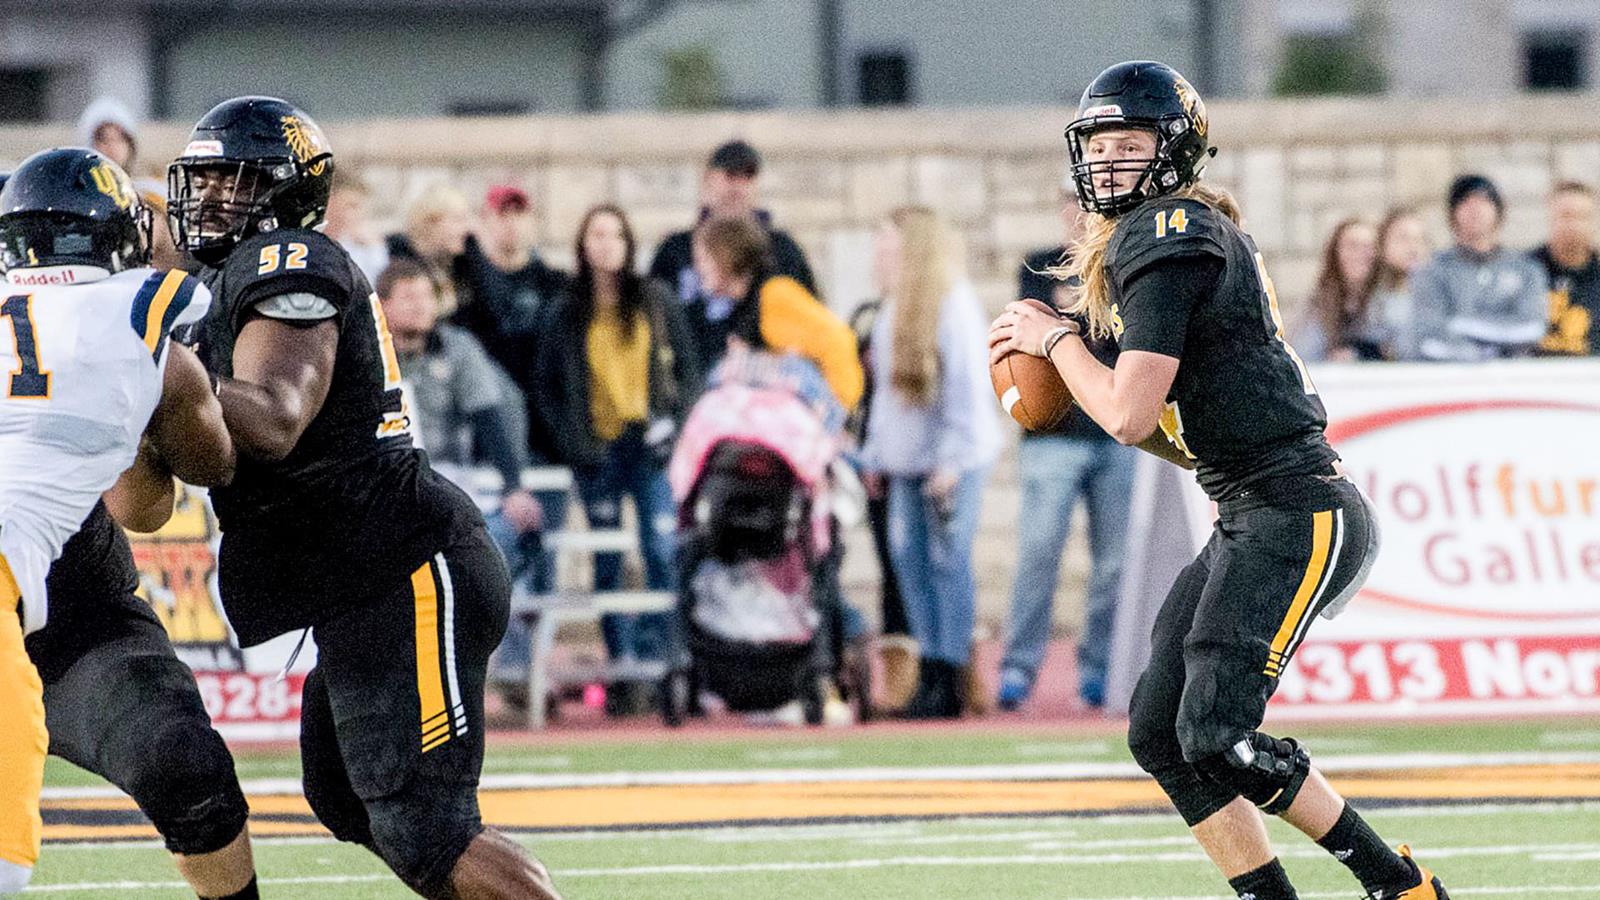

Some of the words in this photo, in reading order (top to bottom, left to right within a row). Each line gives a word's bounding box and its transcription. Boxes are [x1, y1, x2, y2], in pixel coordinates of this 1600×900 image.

[1154, 208, 1189, 239] 14
[258, 242, 308, 275] 52
[14, 269, 76, 285] Riddell
[0, 293, 53, 400] 1
